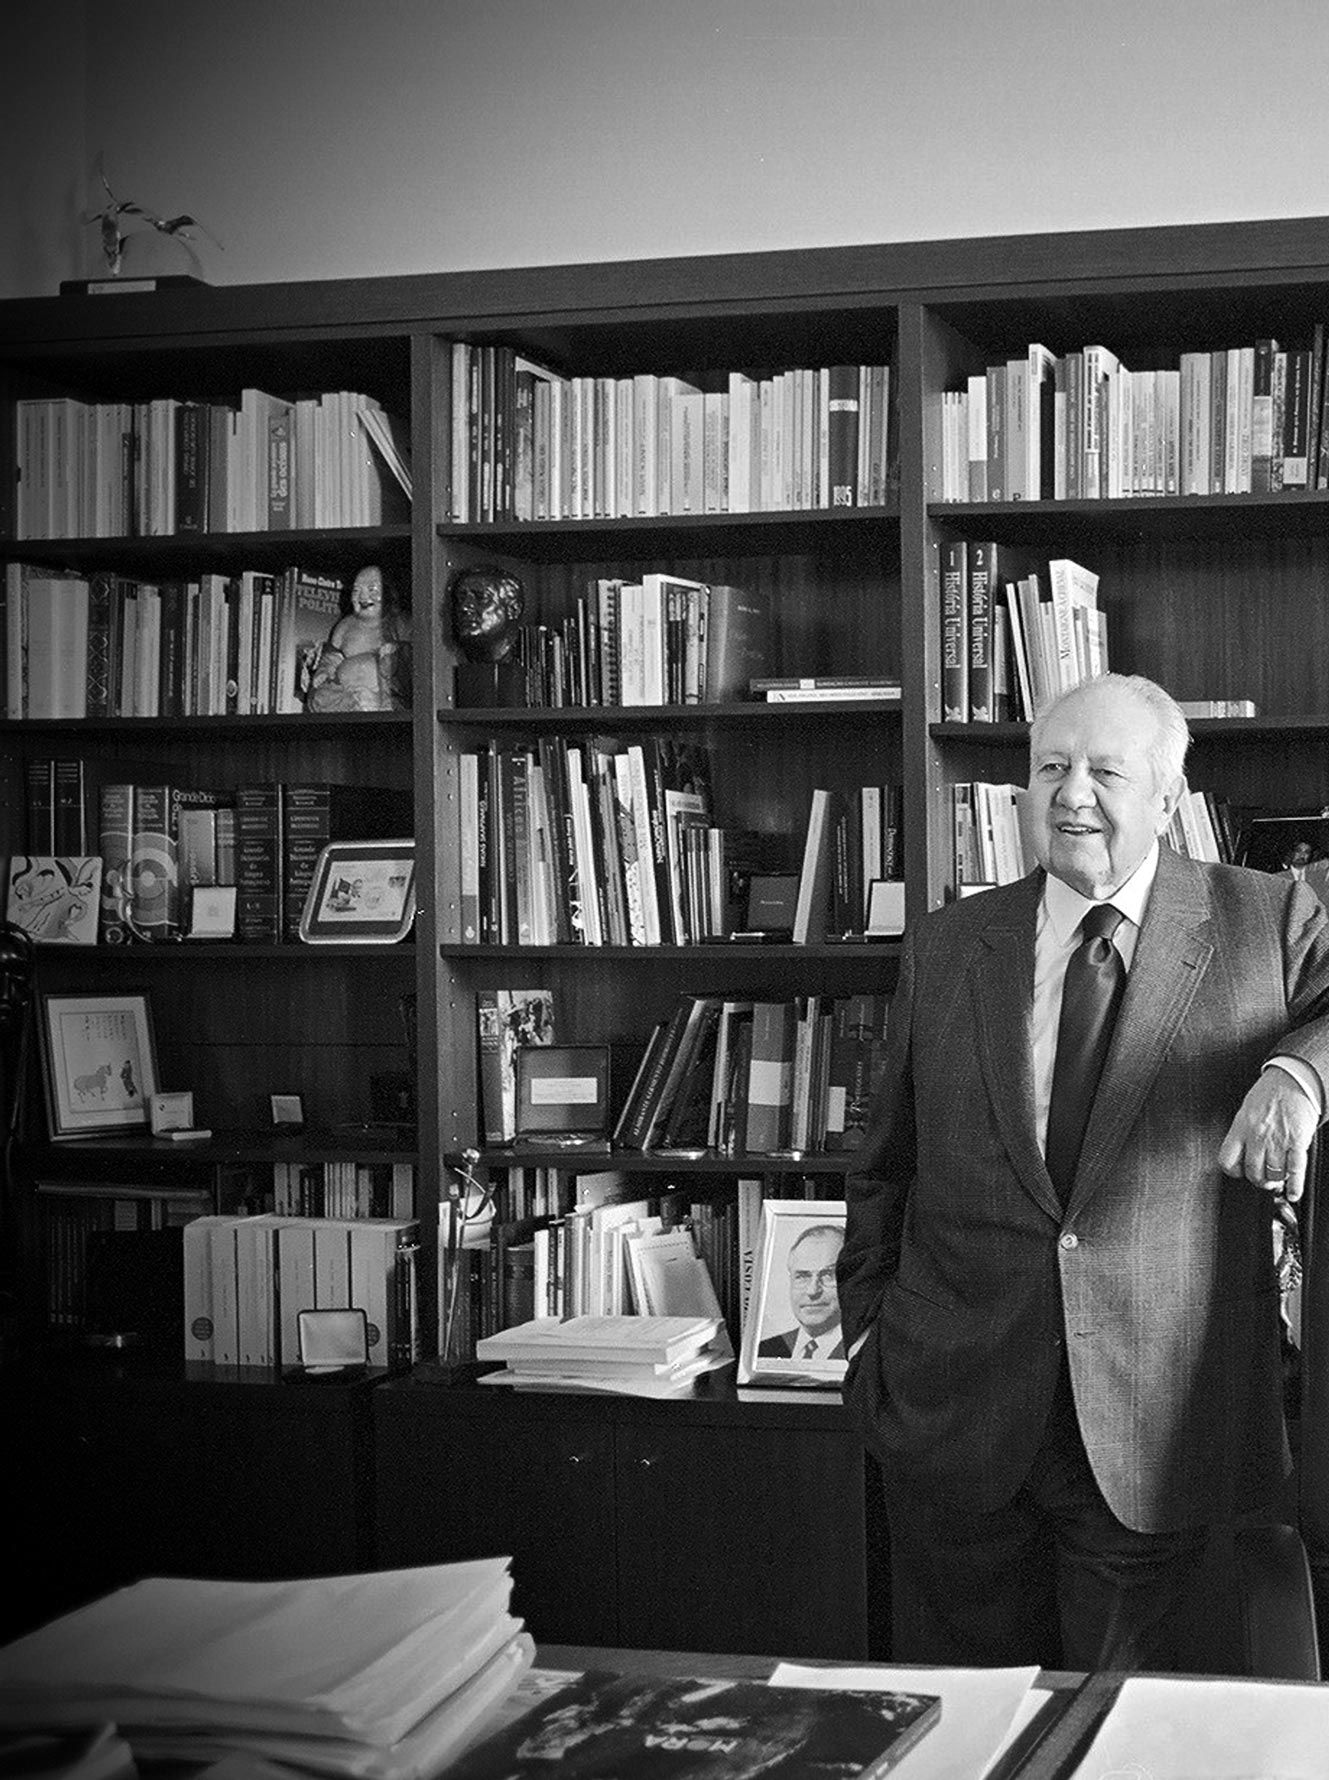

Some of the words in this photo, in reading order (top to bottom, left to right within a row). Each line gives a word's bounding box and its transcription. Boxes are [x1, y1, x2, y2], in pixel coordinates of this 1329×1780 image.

[949, 549, 956, 566] 1
[975, 549, 985, 565] 2
[945, 570, 962, 614] História
[972, 570, 989, 614] História
[945, 616, 962, 668] Universal
[972, 616, 989, 668] Universal
